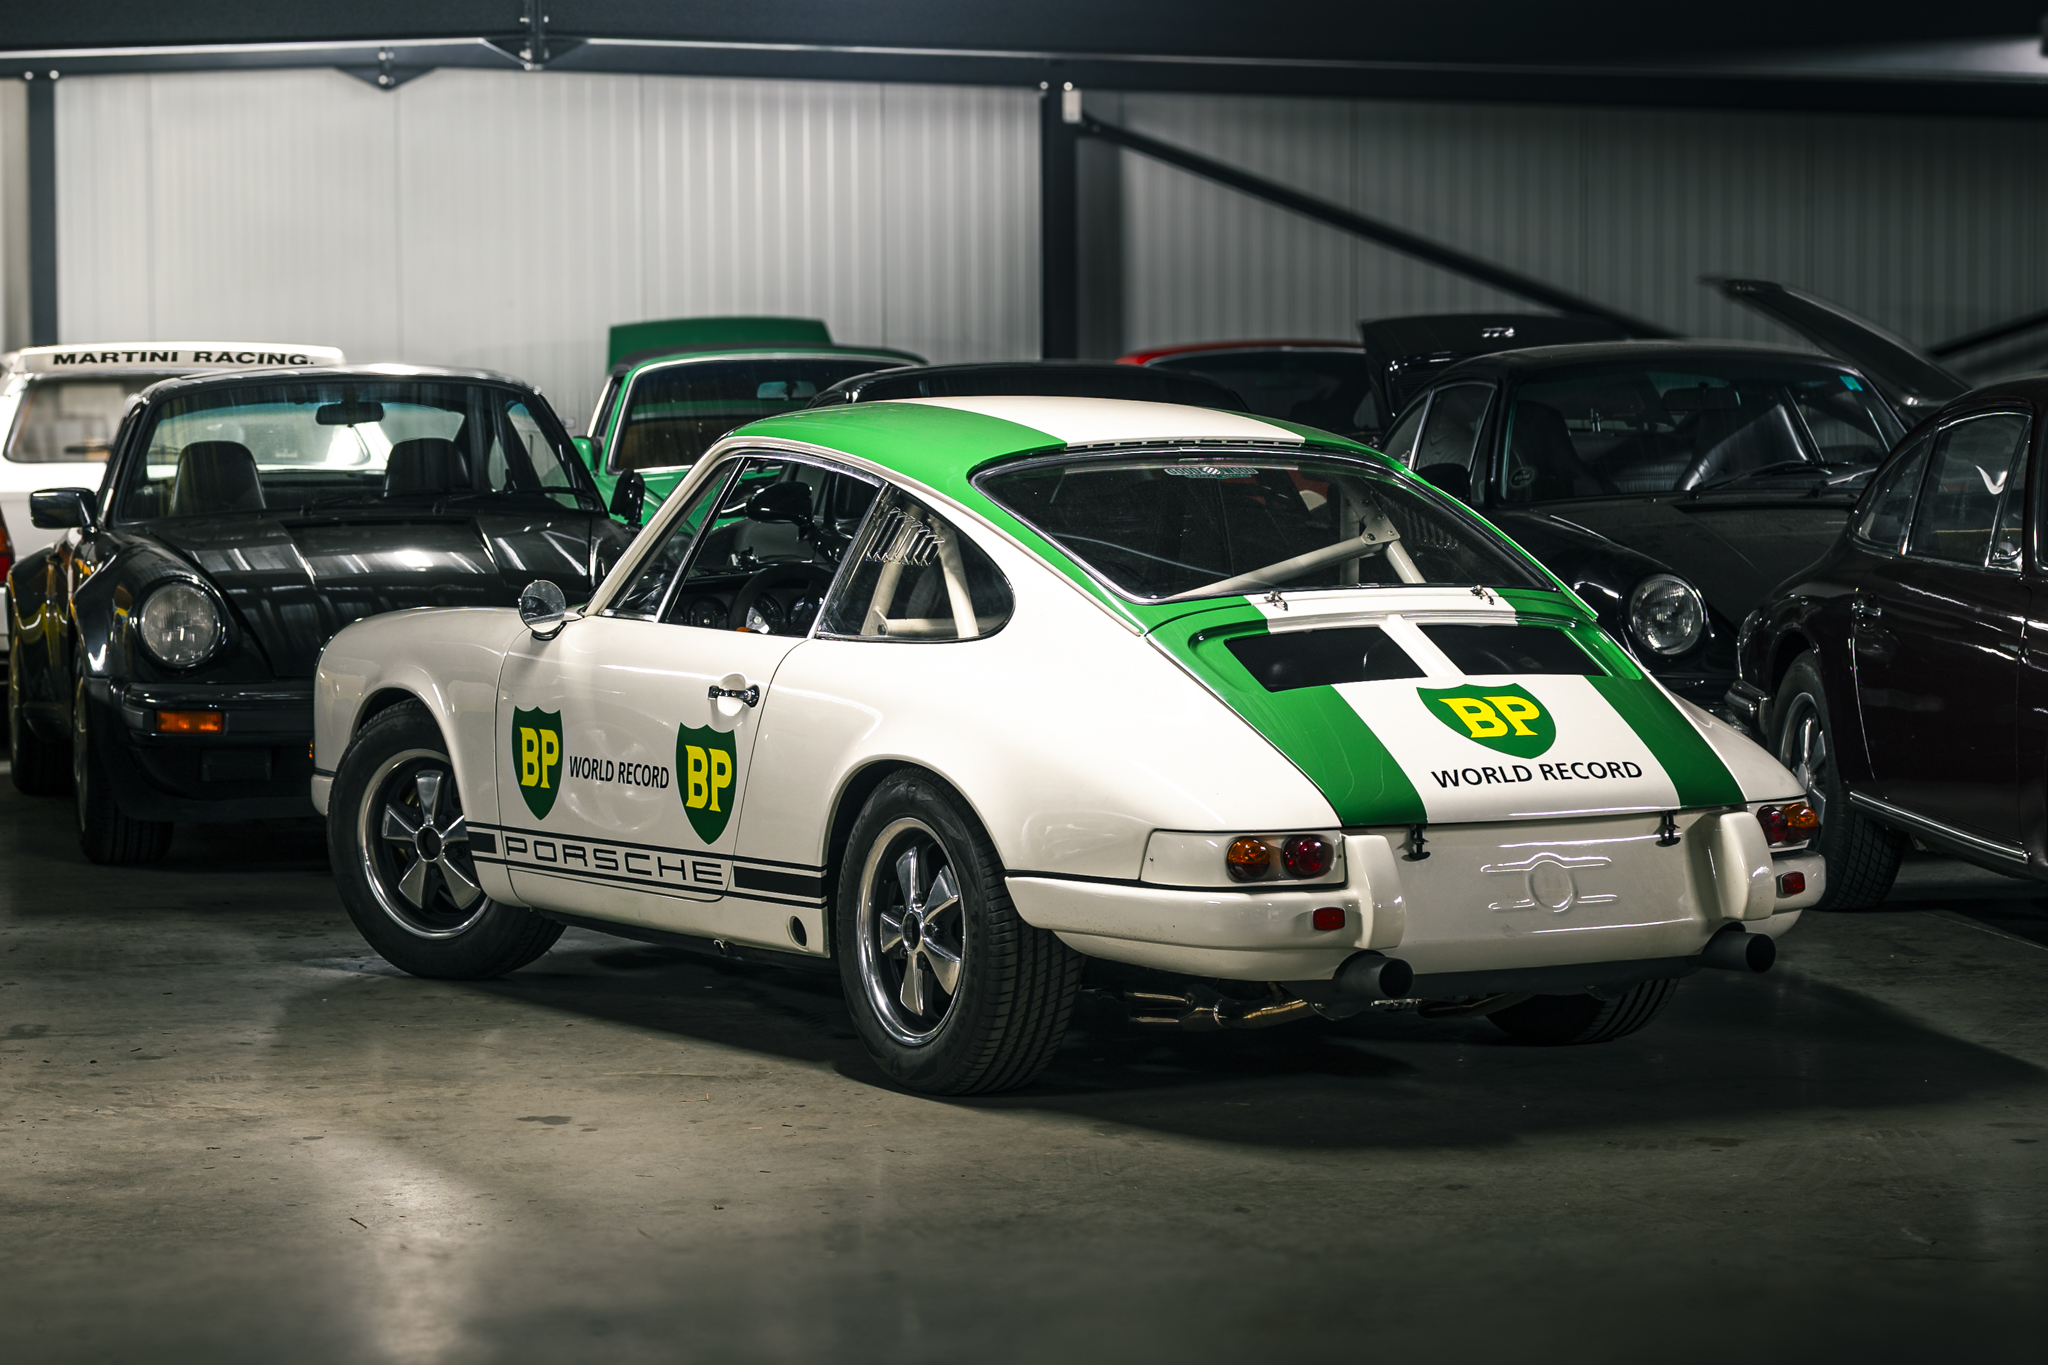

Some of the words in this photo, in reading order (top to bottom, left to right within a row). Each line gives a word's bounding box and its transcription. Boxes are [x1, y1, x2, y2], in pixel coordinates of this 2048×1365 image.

[53, 351, 179, 365] MARTINI
[192, 351, 315, 365] RACING.
[1438, 695, 1540, 738] BP
[519, 726, 560, 790] BP
[569, 755, 615, 783] WORLD
[617, 761, 670, 790] RECORD
[685, 744, 733, 813] BP
[1430, 764, 1534, 789] WORLD
[1538, 761, 1643, 781] RECORD
[504, 835, 724, 886] PORSCHE
